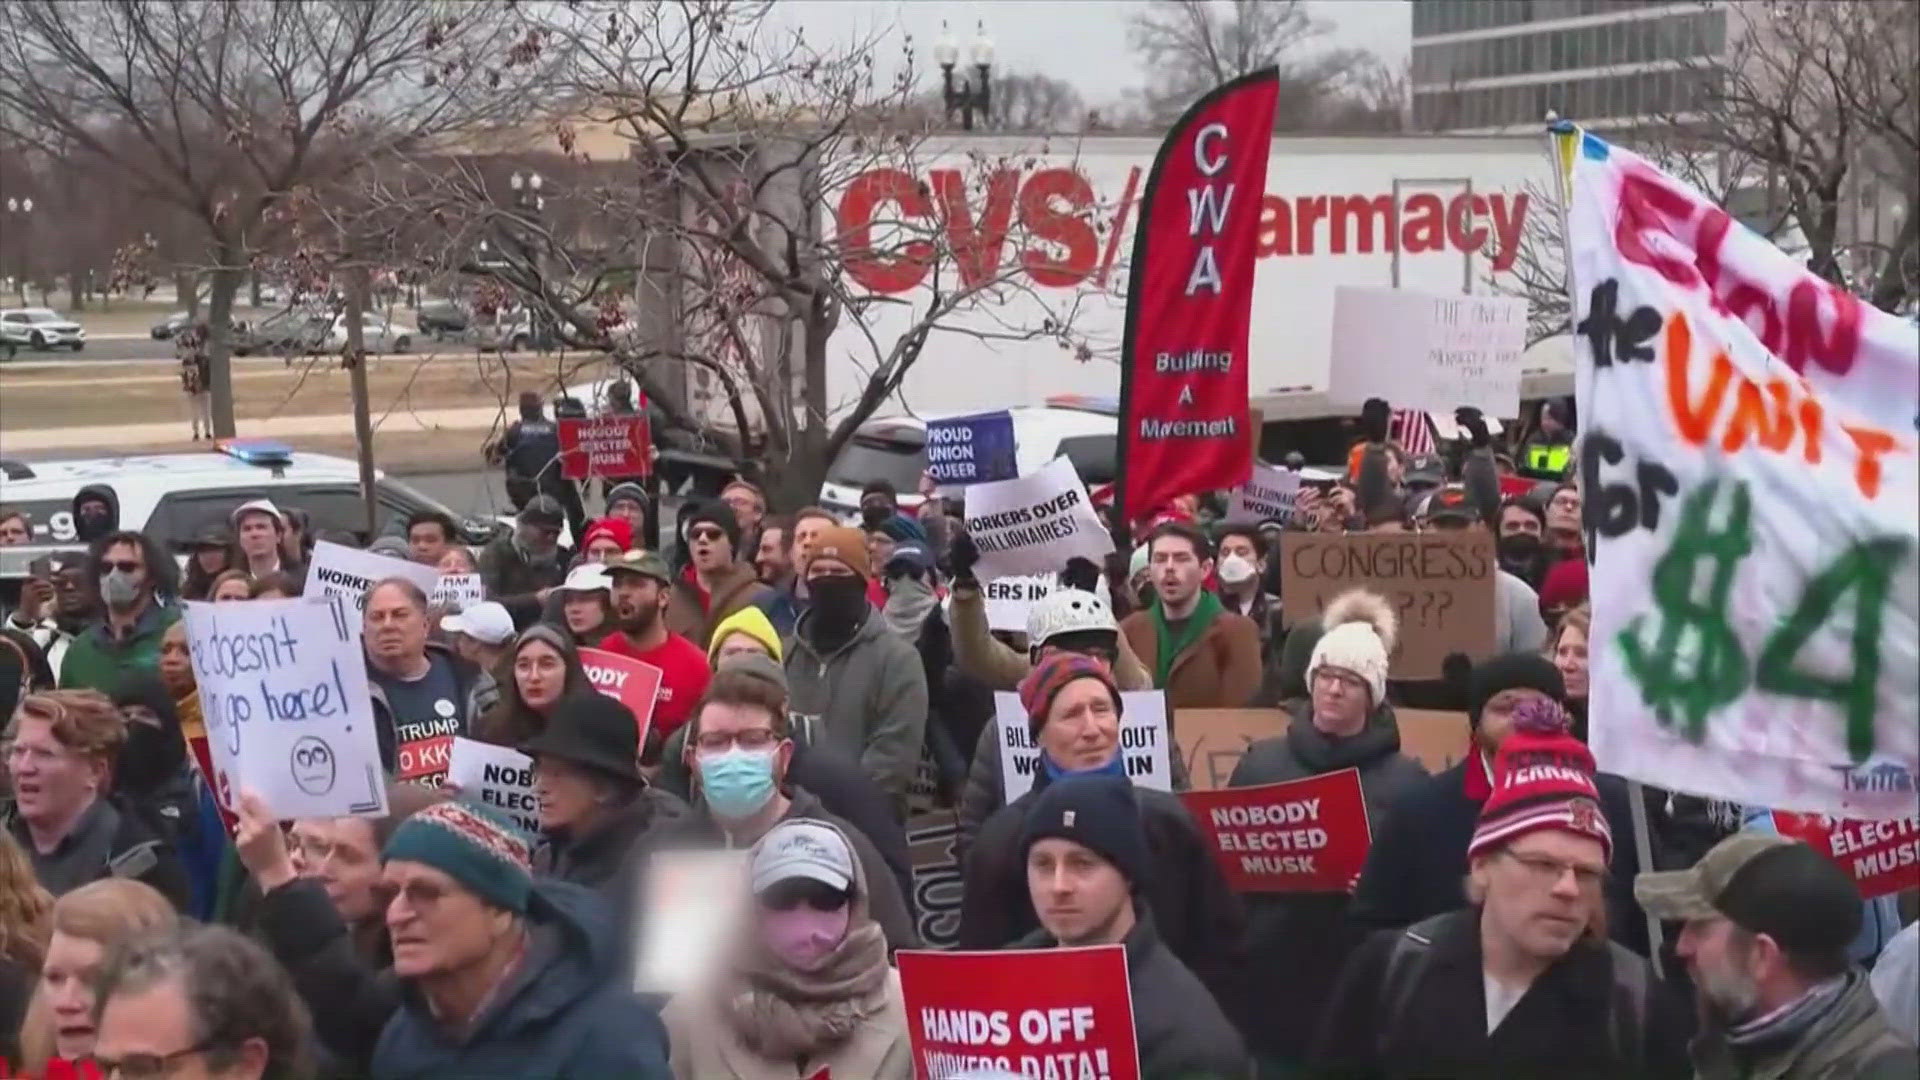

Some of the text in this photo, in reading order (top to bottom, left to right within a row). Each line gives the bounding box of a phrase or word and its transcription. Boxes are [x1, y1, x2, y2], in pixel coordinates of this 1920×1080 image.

[1255, 191, 1529, 272] armacy
[1576, 277, 1663, 367] the
[1177, 384, 1193, 405] A
[928, 426, 973, 444] PROUD
[928, 445, 974, 462] UNION
[929, 462, 976, 479] QUEER
[1032, 489, 1080, 520] OVER
[976, 515, 1079, 552] BILLIONAIRES!
[1293, 543, 1487, 580] CONGRESS
[226, 693, 251, 757] go
[261, 657, 353, 733] here!
[398, 717, 460, 741] TRUMP
[1121, 726, 1158, 748] OUT
[483, 762, 538, 787] NOB
[1127, 755, 1154, 777] IN
[482, 788, 545, 812] ELEC
[1210, 797, 1320, 827] NOBODY
[1217, 828, 1328, 852] ELECTED
[1240, 855, 1316, 875] MUSK
[921, 1006, 1095, 1046] HANDS OFF
[1021, 1048, 1111, 1080] DATA!
